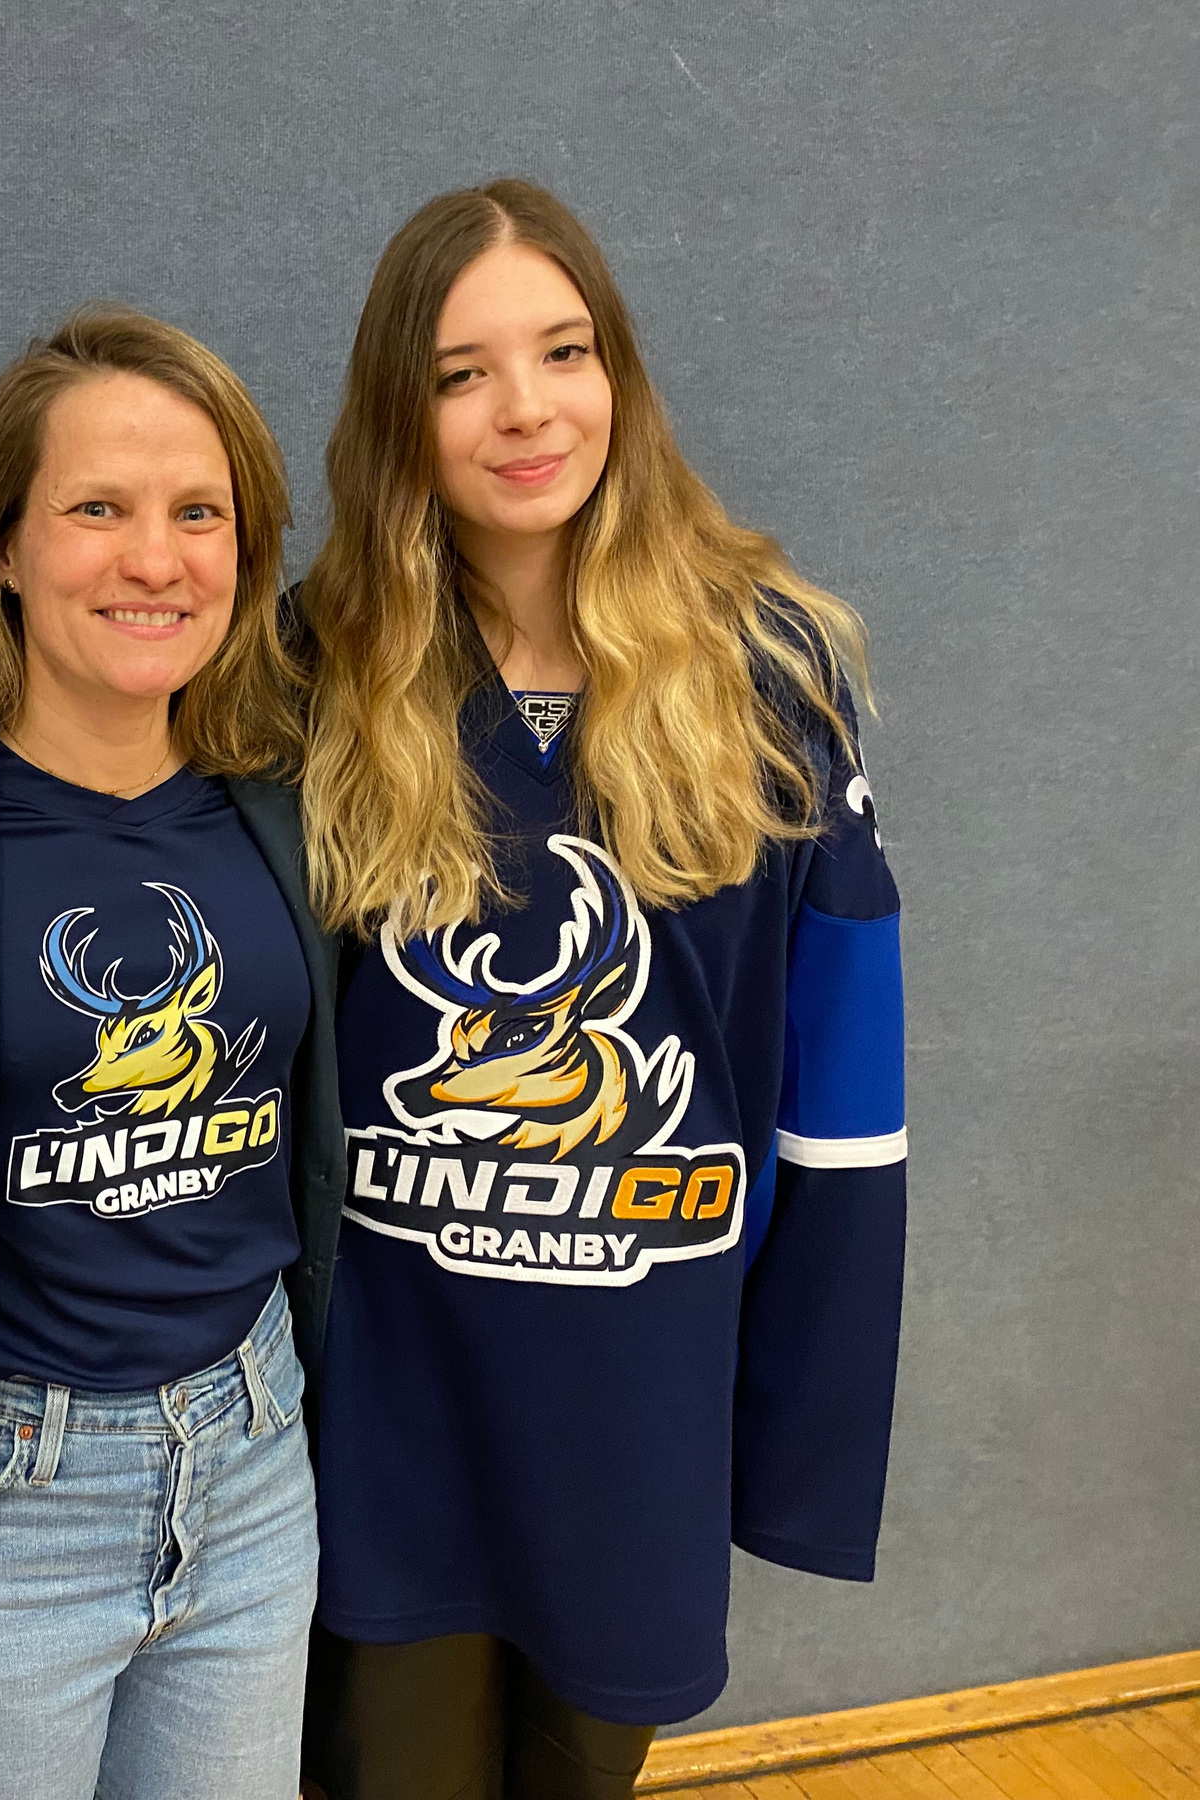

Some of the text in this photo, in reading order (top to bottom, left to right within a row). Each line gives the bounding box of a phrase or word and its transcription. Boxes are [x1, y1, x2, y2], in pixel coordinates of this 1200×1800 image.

[21, 1100, 276, 1190] L'INDIGO
[95, 1164, 223, 1214] GRANBY
[353, 1148, 733, 1220] L'INDIGO
[440, 1222, 637, 1267] GRANBY
